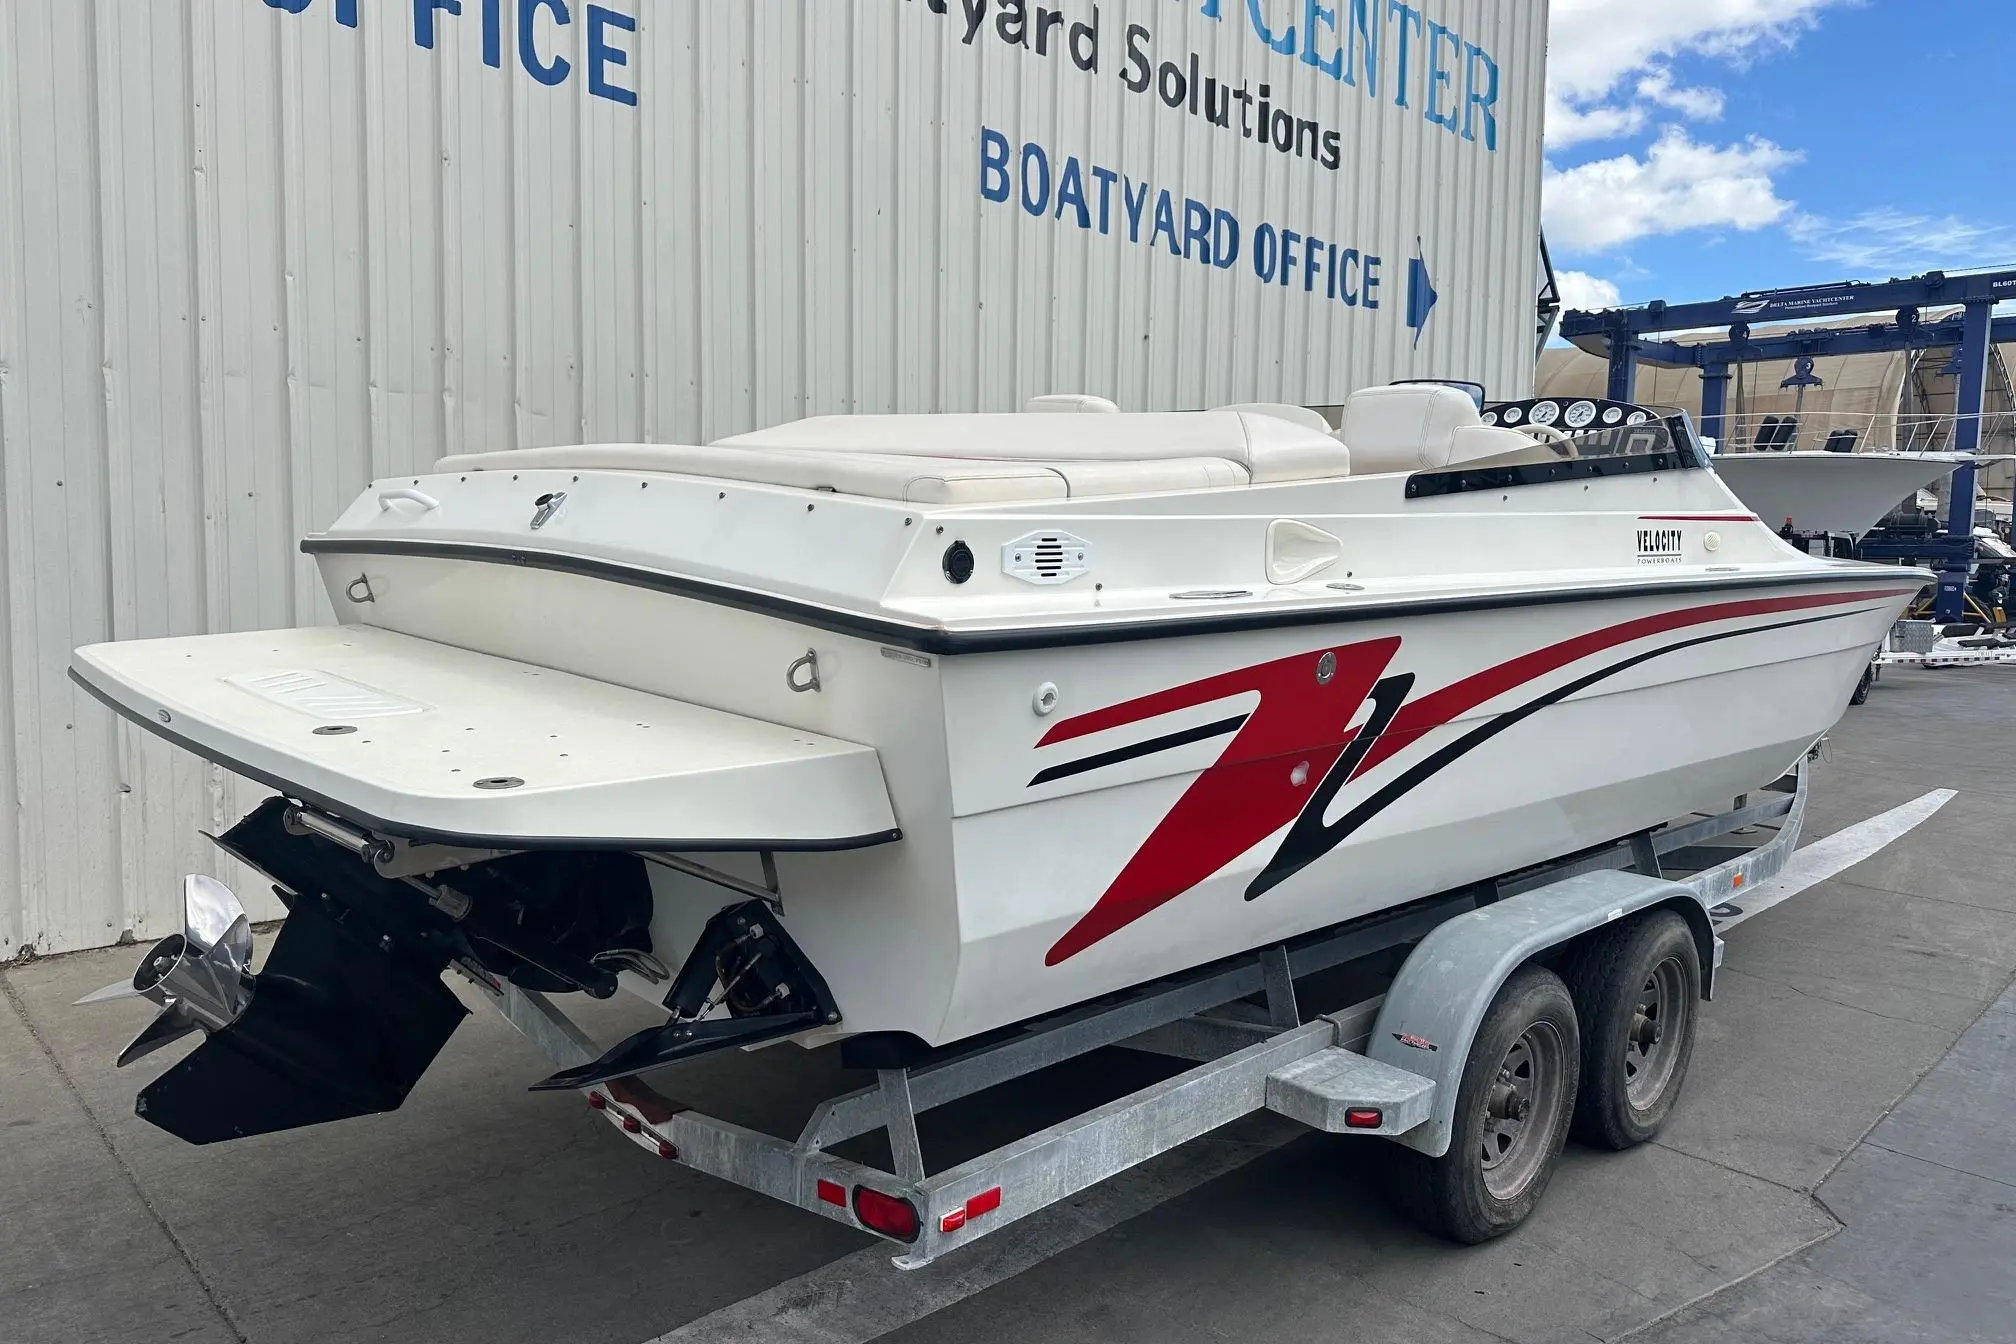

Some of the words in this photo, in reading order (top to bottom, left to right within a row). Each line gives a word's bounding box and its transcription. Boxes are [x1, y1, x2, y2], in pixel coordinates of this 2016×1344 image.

[927, 0, 1099, 75] yard
[1119, 24, 1340, 170] Solutions
[980, 125, 1240, 269] BOATYARD
[1253, 222, 1382, 310] OFFICE
[1911, 314, 1917, 323] 2
[1806, 362, 1811, 370] 3
[1636, 530, 1682, 552] VELOCITY
[1637, 557, 1682, 565] POWERBOATS
